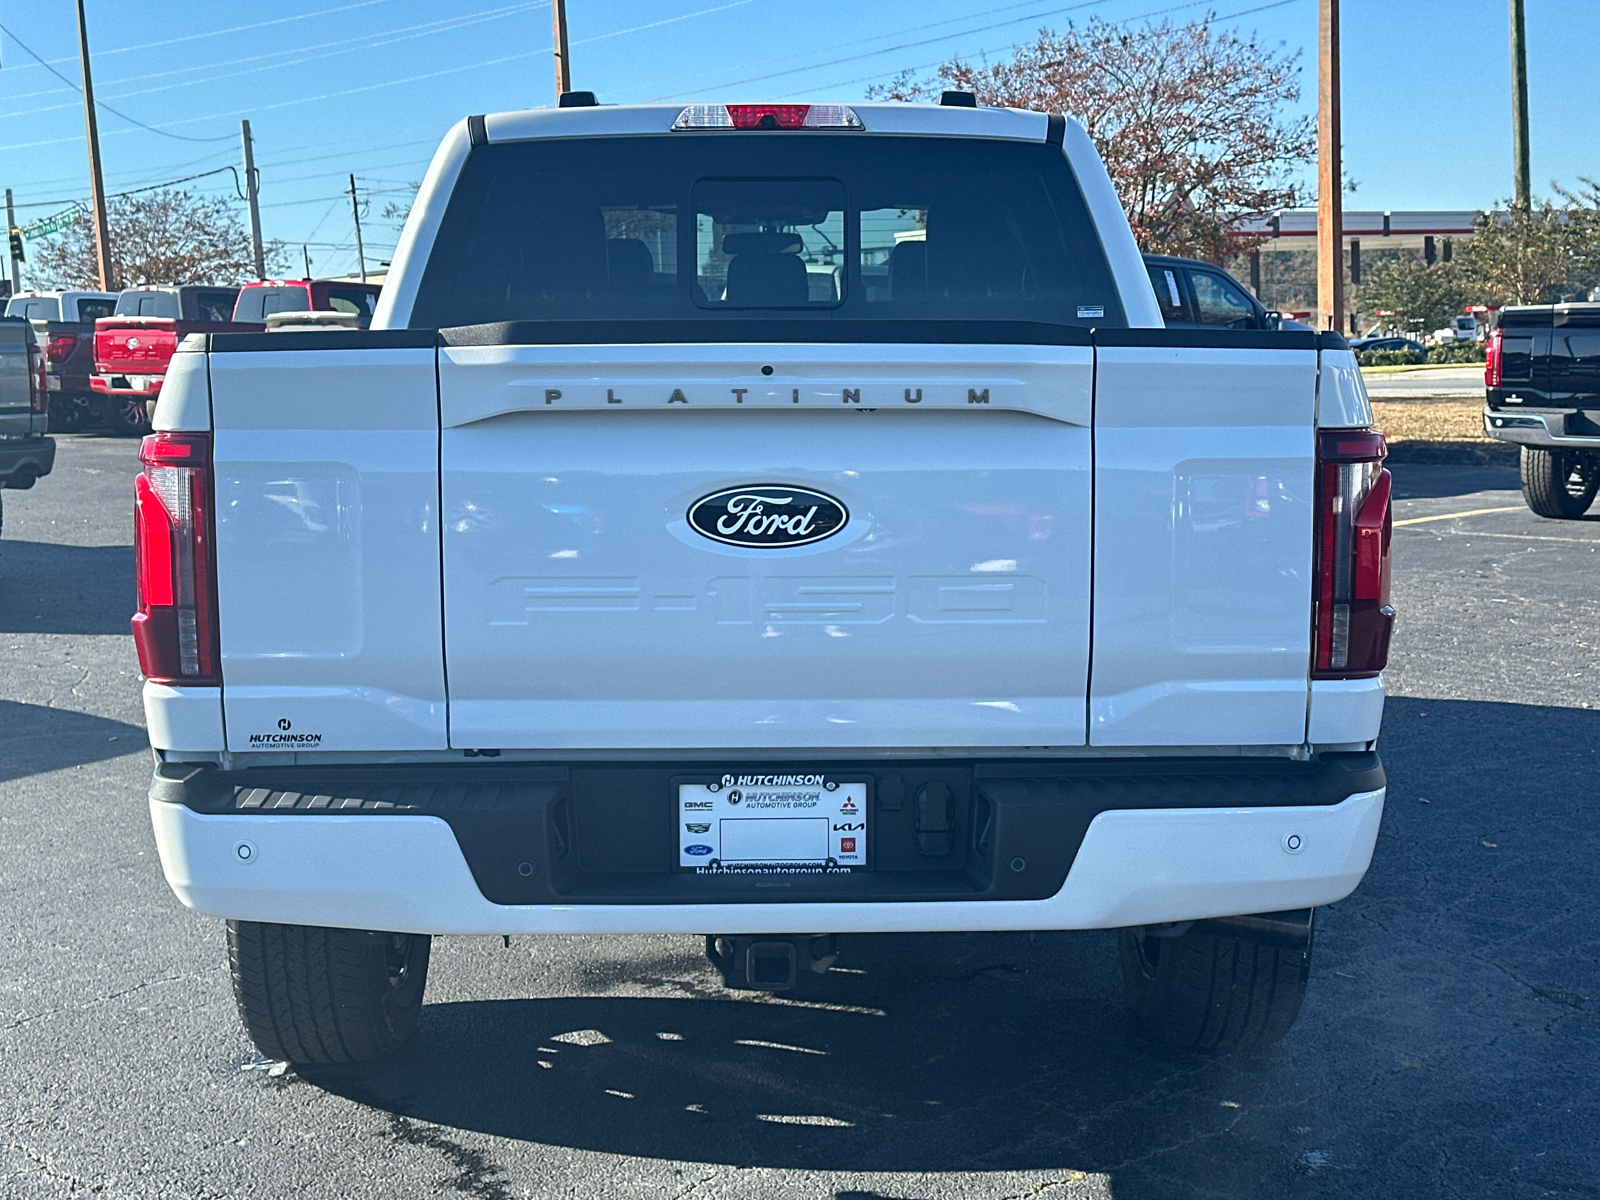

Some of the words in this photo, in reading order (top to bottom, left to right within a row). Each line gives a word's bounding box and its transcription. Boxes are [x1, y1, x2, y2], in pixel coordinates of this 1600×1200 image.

[544, 388, 990, 406] PLATINUM
[717, 495, 819, 536] Ford
[488, 575, 1048, 625] F-150
[249, 734, 322, 743] HUTCHINSON
[737, 774, 825, 787] HUTCHINSON
[744, 791, 820, 803] HUTCHINSON
